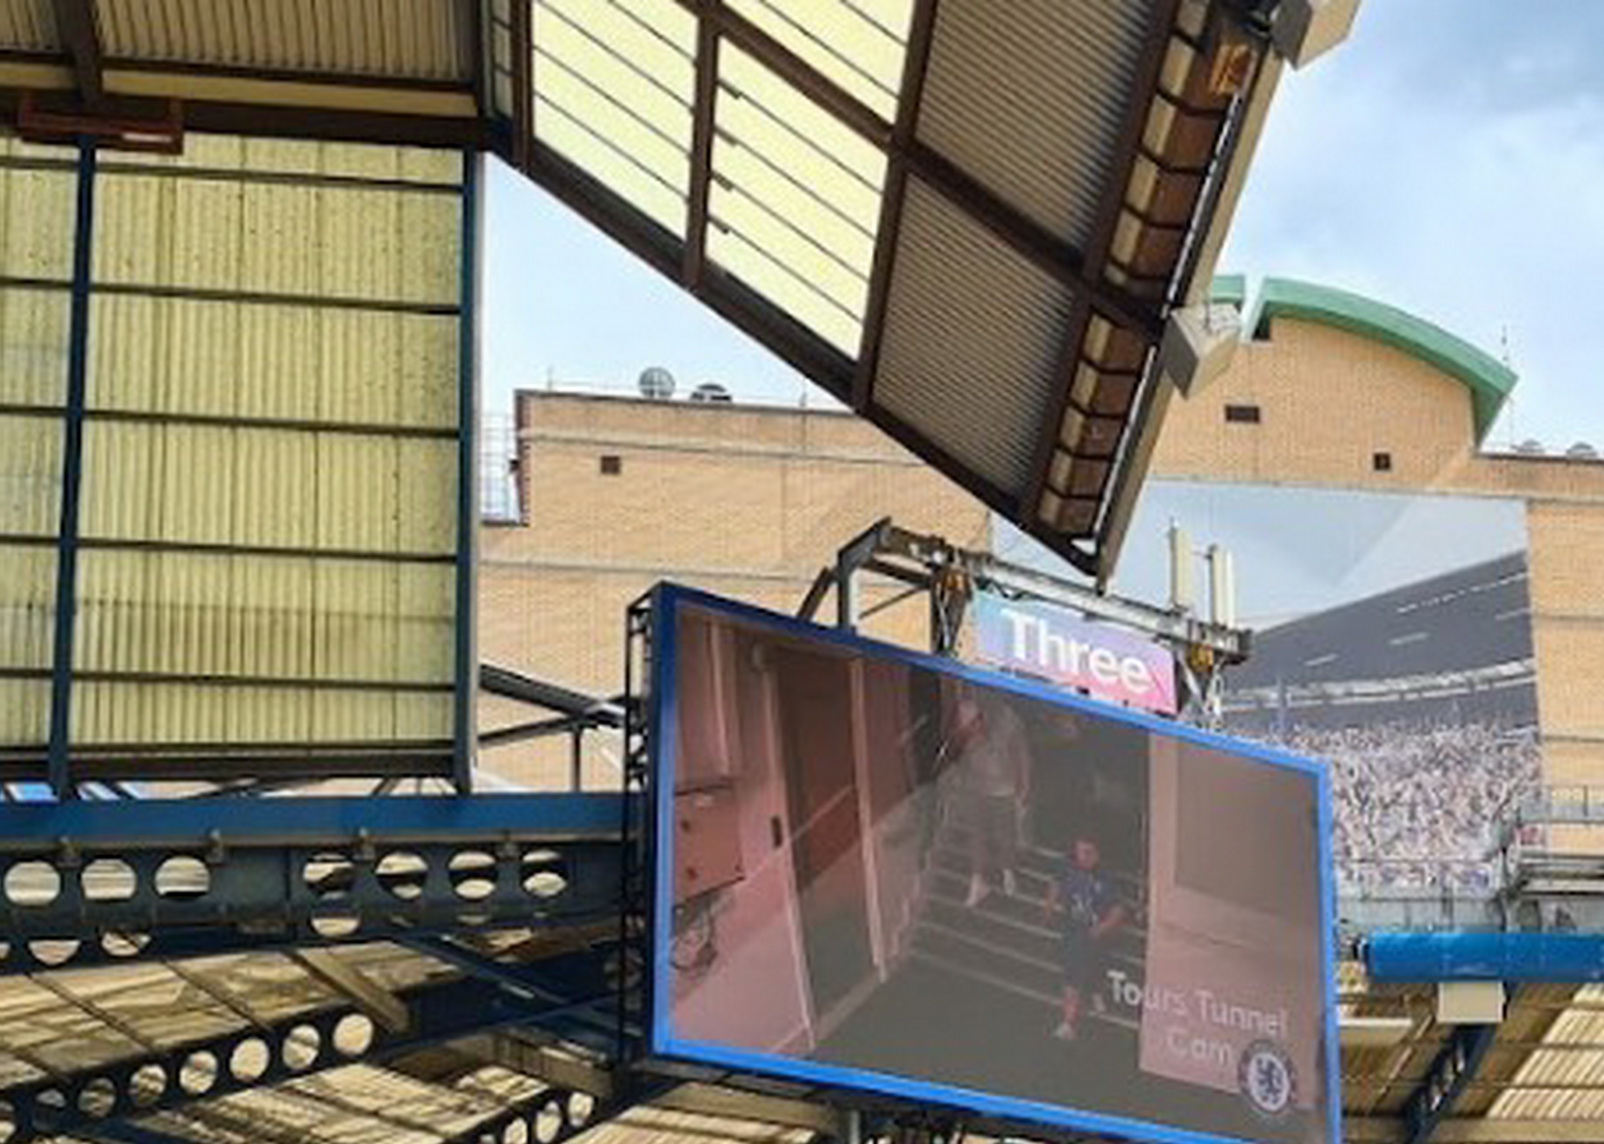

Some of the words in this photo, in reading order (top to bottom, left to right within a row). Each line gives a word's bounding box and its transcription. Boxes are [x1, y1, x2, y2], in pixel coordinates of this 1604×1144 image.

[1000, 607, 1154, 694] Three
[1106, 969, 1189, 1016] Tours
[1193, 988, 1288, 1038] Tunnel
